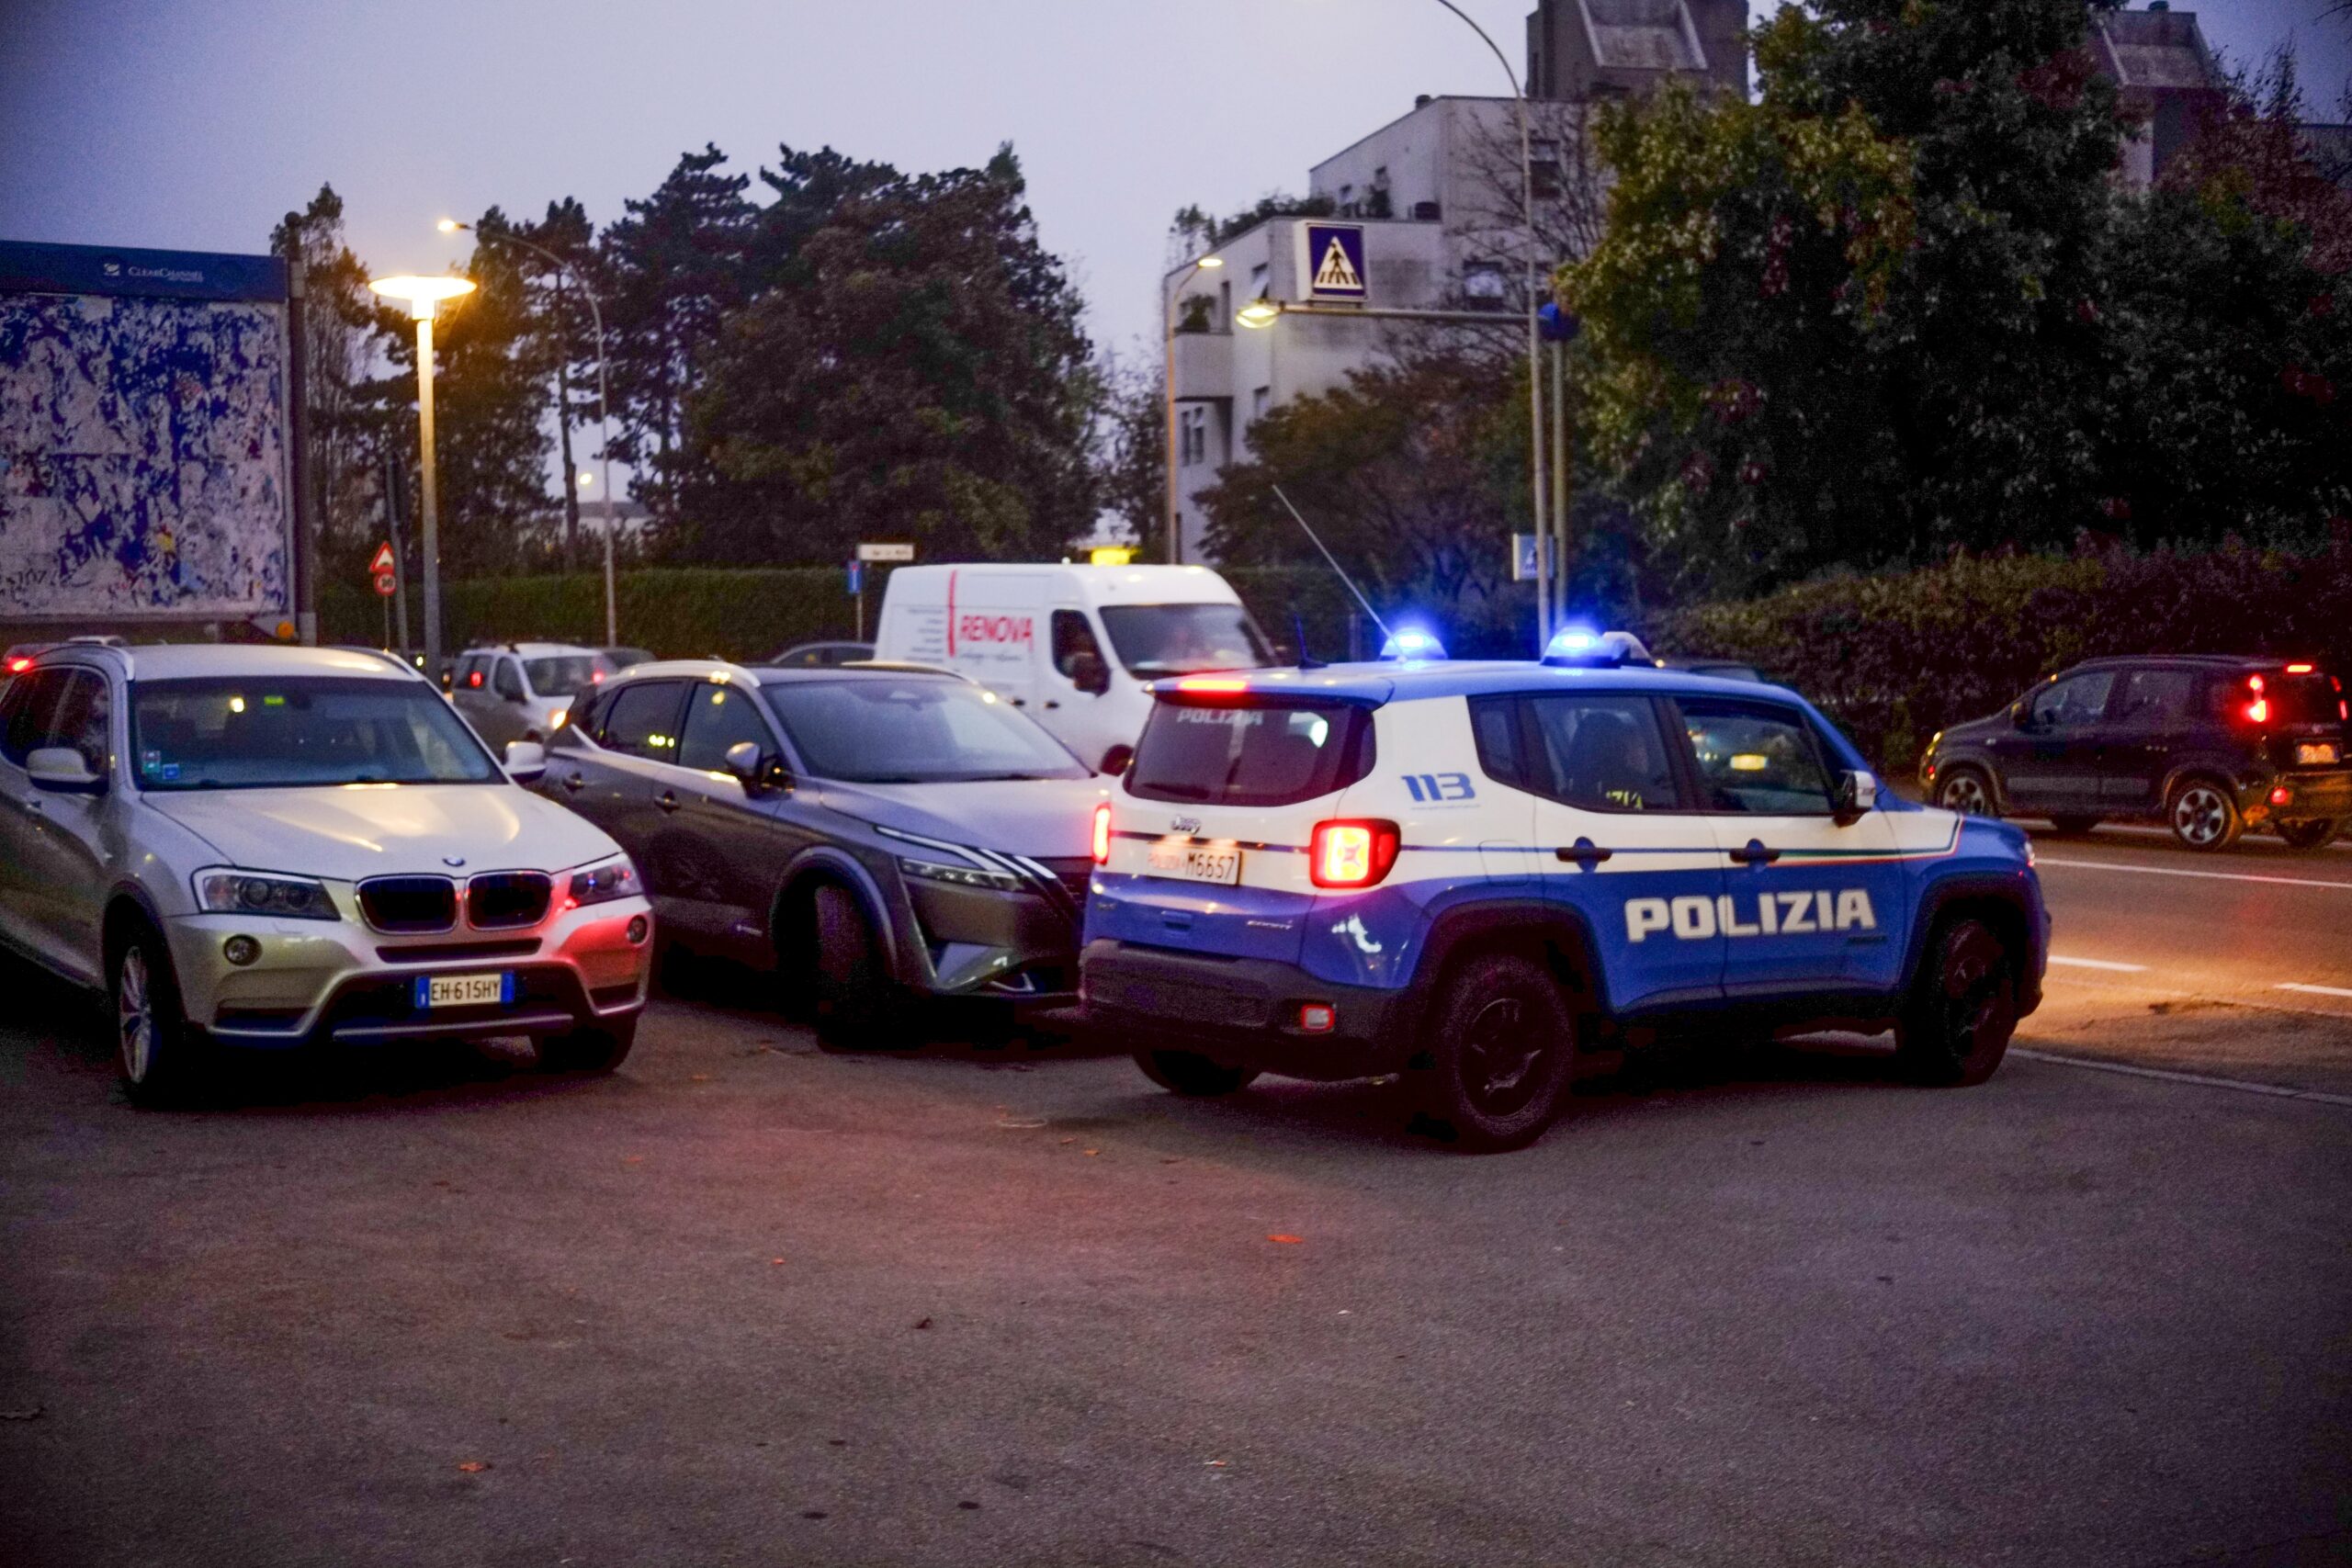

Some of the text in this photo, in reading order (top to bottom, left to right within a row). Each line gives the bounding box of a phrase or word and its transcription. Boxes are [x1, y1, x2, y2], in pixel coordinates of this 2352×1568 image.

[960, 615, 1034, 651] RENOVA
[1400, 773, 1476, 802] 113
[1185, 852, 1235, 881] M6657
[1624, 888, 1876, 942] POLIZIA
